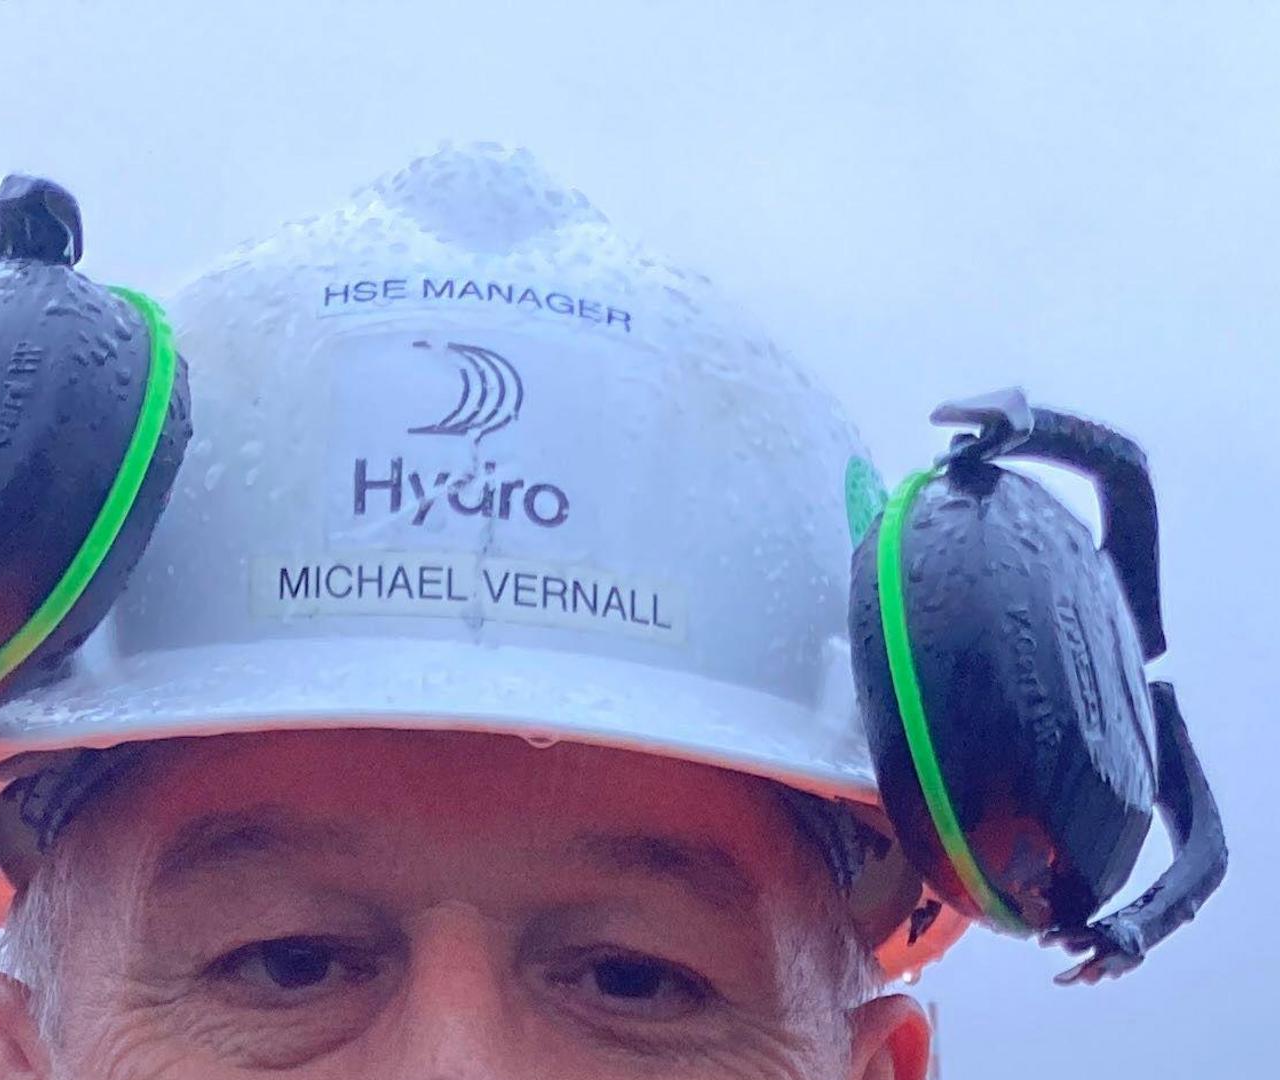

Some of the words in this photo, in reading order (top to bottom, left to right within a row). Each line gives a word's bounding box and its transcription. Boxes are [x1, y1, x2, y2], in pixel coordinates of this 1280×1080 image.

[323, 279, 407, 306] HSE
[423, 279, 632, 332] MANAGER
[353, 457, 570, 528] Hydro
[279, 565, 469, 602] MICHAEL
[483, 569, 672, 630] VERNALL
